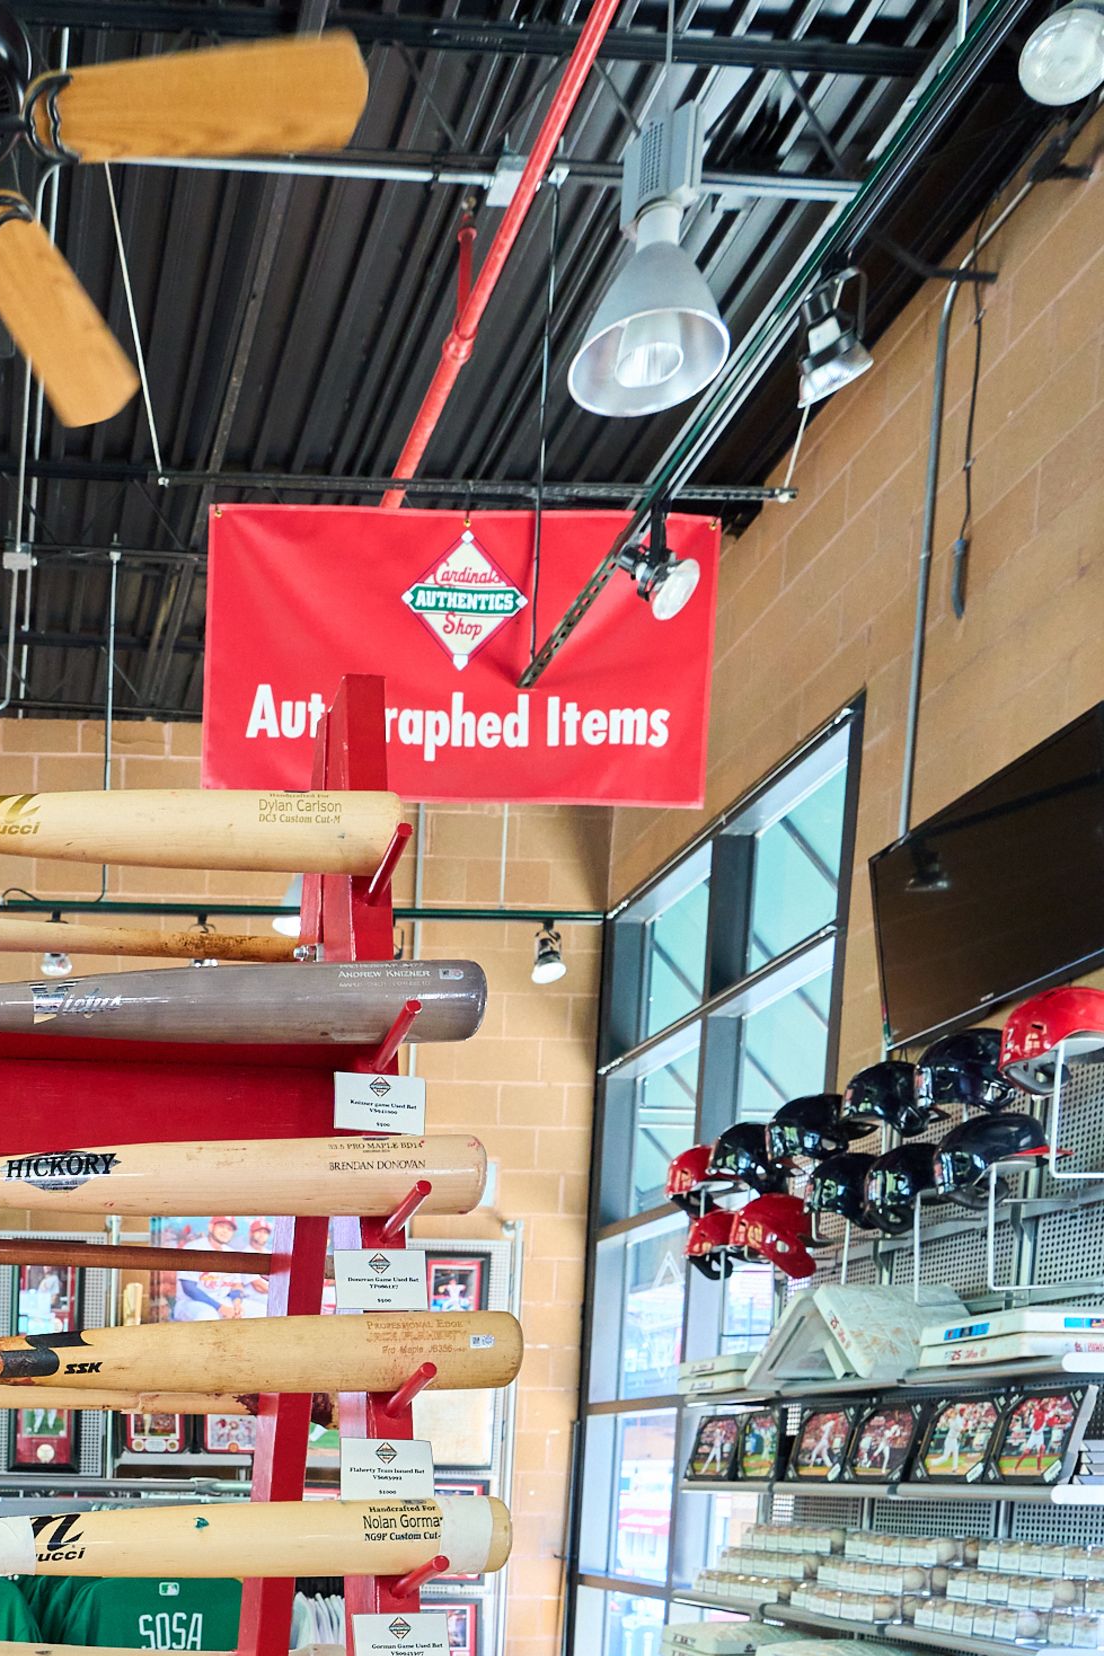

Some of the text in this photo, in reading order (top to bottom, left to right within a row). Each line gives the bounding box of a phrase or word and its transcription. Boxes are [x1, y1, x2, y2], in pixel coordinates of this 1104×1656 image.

[433, 560, 505, 588] Cardinals
[413, 588, 514, 612] AUTHENTICS
[443, 613, 483, 640] Shop
[245, 683, 671, 762] Autraphed Items
[259, 799, 342, 813] Dylan Carlson
[259, 813, 341, 824] DC3 Custom Cut-M
[6, 1152, 117, 1178] HICKORY
[330, 1160, 426, 1172] BRENDAN DONOVAN
[64, 1361, 103, 1375] SSK
[363, 1514, 444, 1529] Nolan Gorma
[389, 1532, 422, 1541] Custom
[139, 1612, 202, 1651] SOSA
